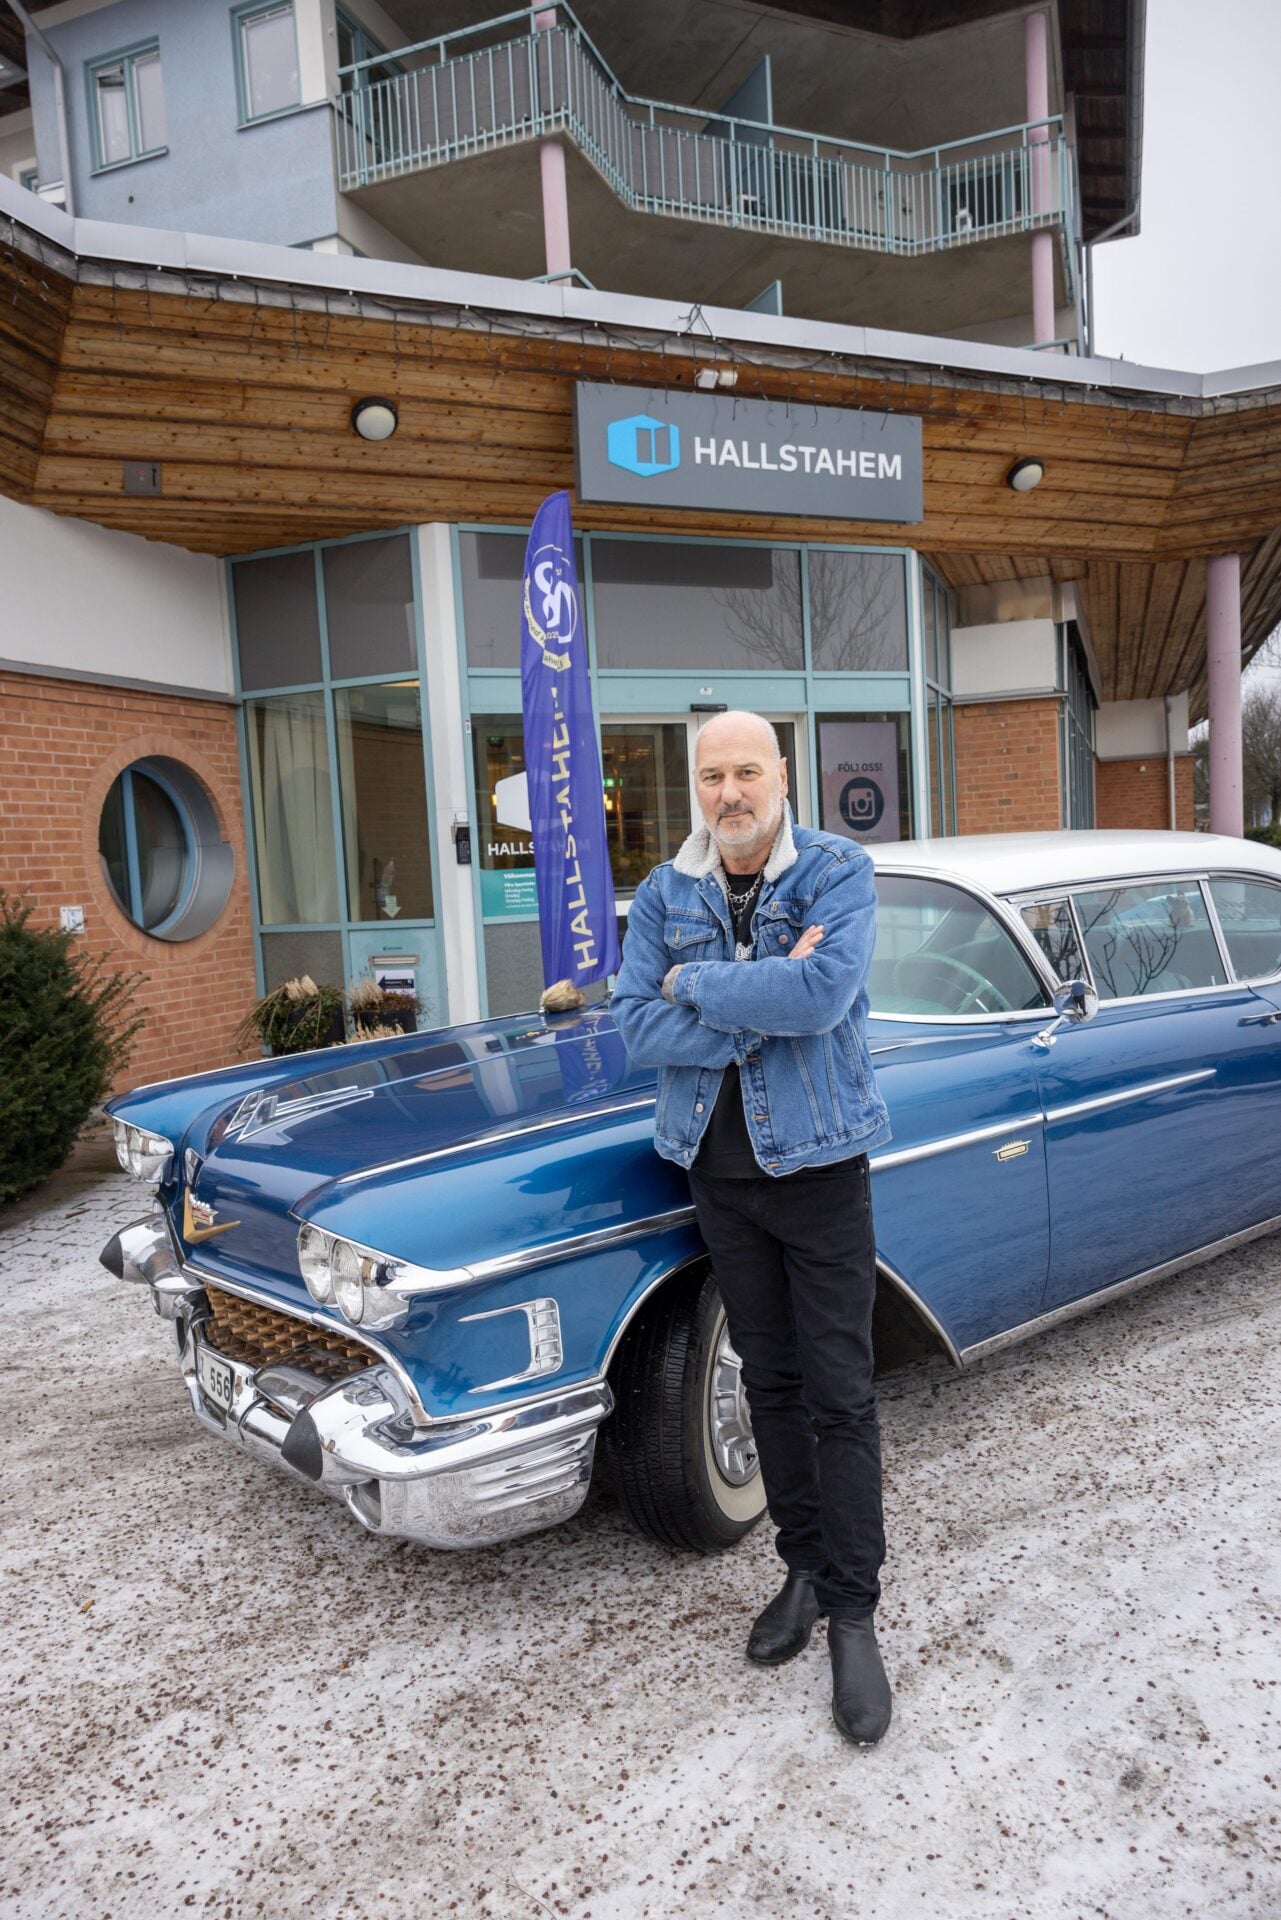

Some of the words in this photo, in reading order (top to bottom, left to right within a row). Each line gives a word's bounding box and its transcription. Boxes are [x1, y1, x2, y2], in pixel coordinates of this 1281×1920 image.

[694, 436, 902, 481] HALLSTAHEM
[837, 761, 859, 772] FÖLJ
[861, 762, 883, 772] OSS!
[210, 1366, 231, 1402] 556
